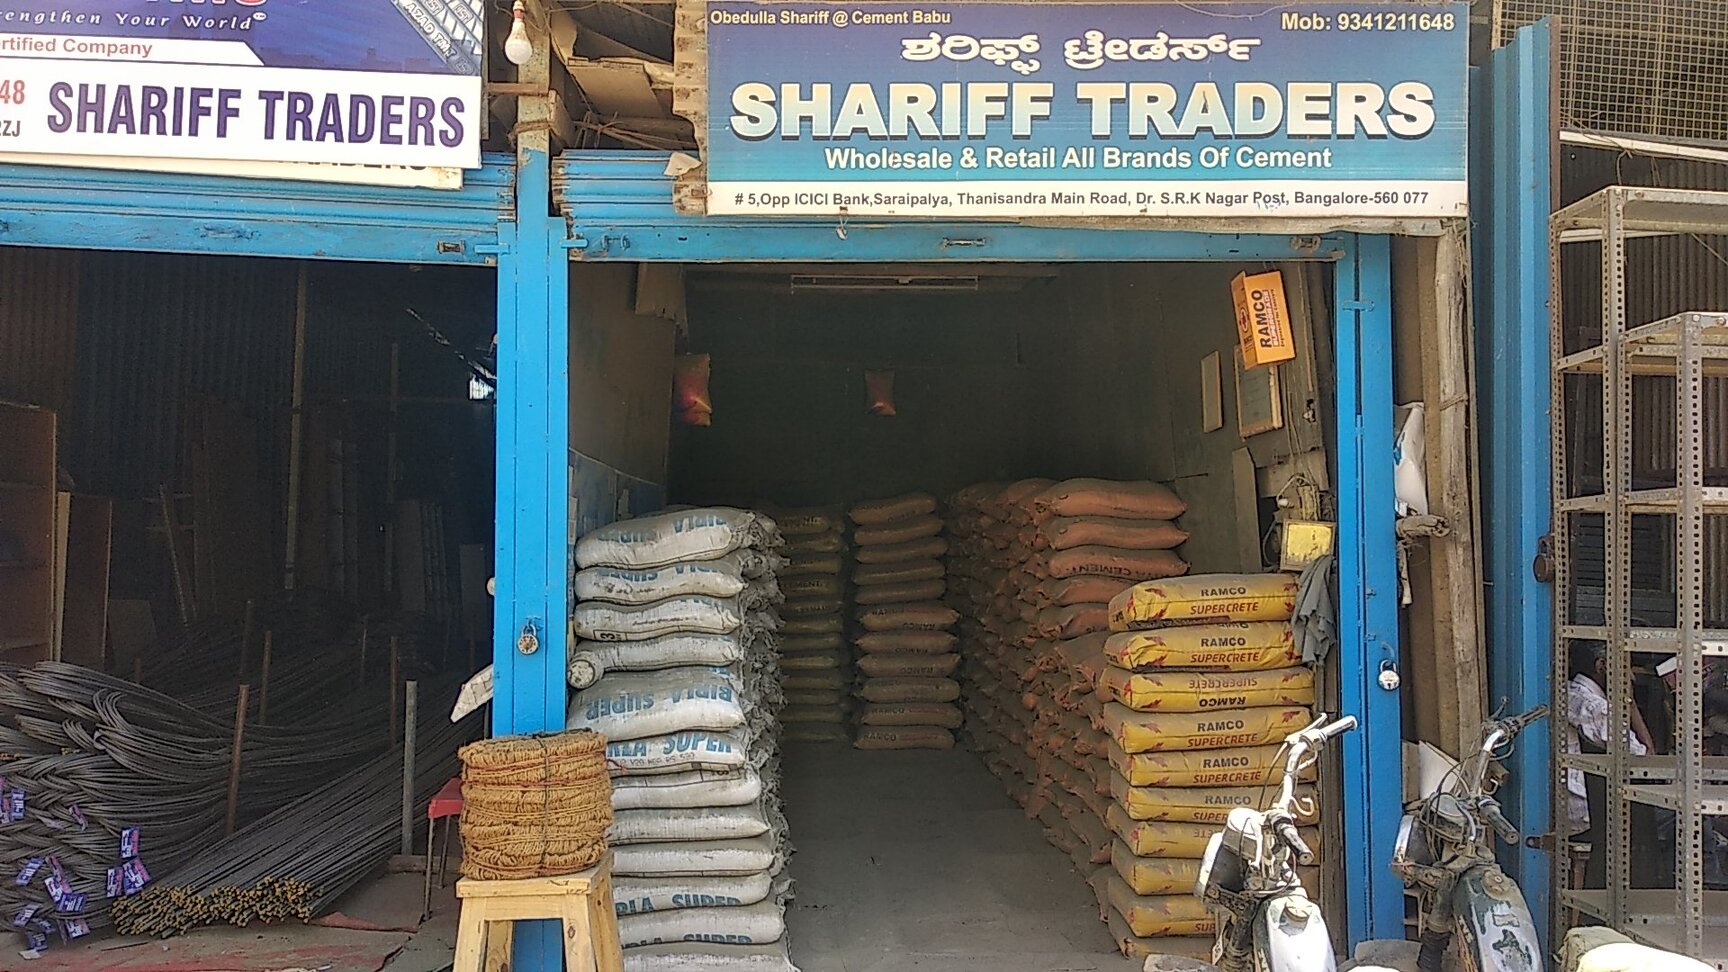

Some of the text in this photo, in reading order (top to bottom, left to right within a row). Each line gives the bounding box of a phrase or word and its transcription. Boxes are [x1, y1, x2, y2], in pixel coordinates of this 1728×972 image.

[0, 10, 102, 25] engthen
[115, 13, 170, 27] Your
[183, 15, 252, 30] World
[404, 2, 435, 34] AZAD
[710, 10, 950, 27] Obedulla Shariff @ Cement Babu
[1281, 12, 1455, 31] Mob: 9341211648
[0, 36, 152, 57] rtified Company
[47, 80, 465, 148] SHARIFF TRADERS
[730, 81, 1437, 141] SHARIFF TRADERS
[825, 146, 1332, 169] Wholesale & Retail All Brands Of Cement
[735, 193, 743, 204] #
[794, 193, 828, 205] ICICI
[957, 192, 1046, 205] Thanisandra
[1051, 192, 1085, 204] Main
[1090, 191, 1131, 206] Road,
[1136, 191, 1156, 204] Dr.
[1161, 191, 1200, 204] S.R.K
[1205, 191, 1249, 207] Nagar
[1253, 191, 1289, 206] Post,
[1294, 190, 1399, 207] Bangalore-560
[1403, 190, 1429, 204] 077
[1251, 289, 1273, 348] RAMCO
[1200, 586, 1247, 597] RAMCO
[1190, 602, 1259, 615] SUPERCRETE
[1201, 637, 1246, 647] RAMCO
[1190, 652, 1260, 663] SUPERCRETE
[1189, 679, 1258, 689] SUPERCRETE
[1199, 697, 1246, 707] RAMCO
[1197, 720, 1244, 732] RAMCO
[1188, 733, 1258, 748] SUPERCRETE
[1203, 757, 1249, 768] RAMCO
[1193, 771, 1261, 783] SUPERCRETE
[1205, 796, 1252, 805] RAMCO
